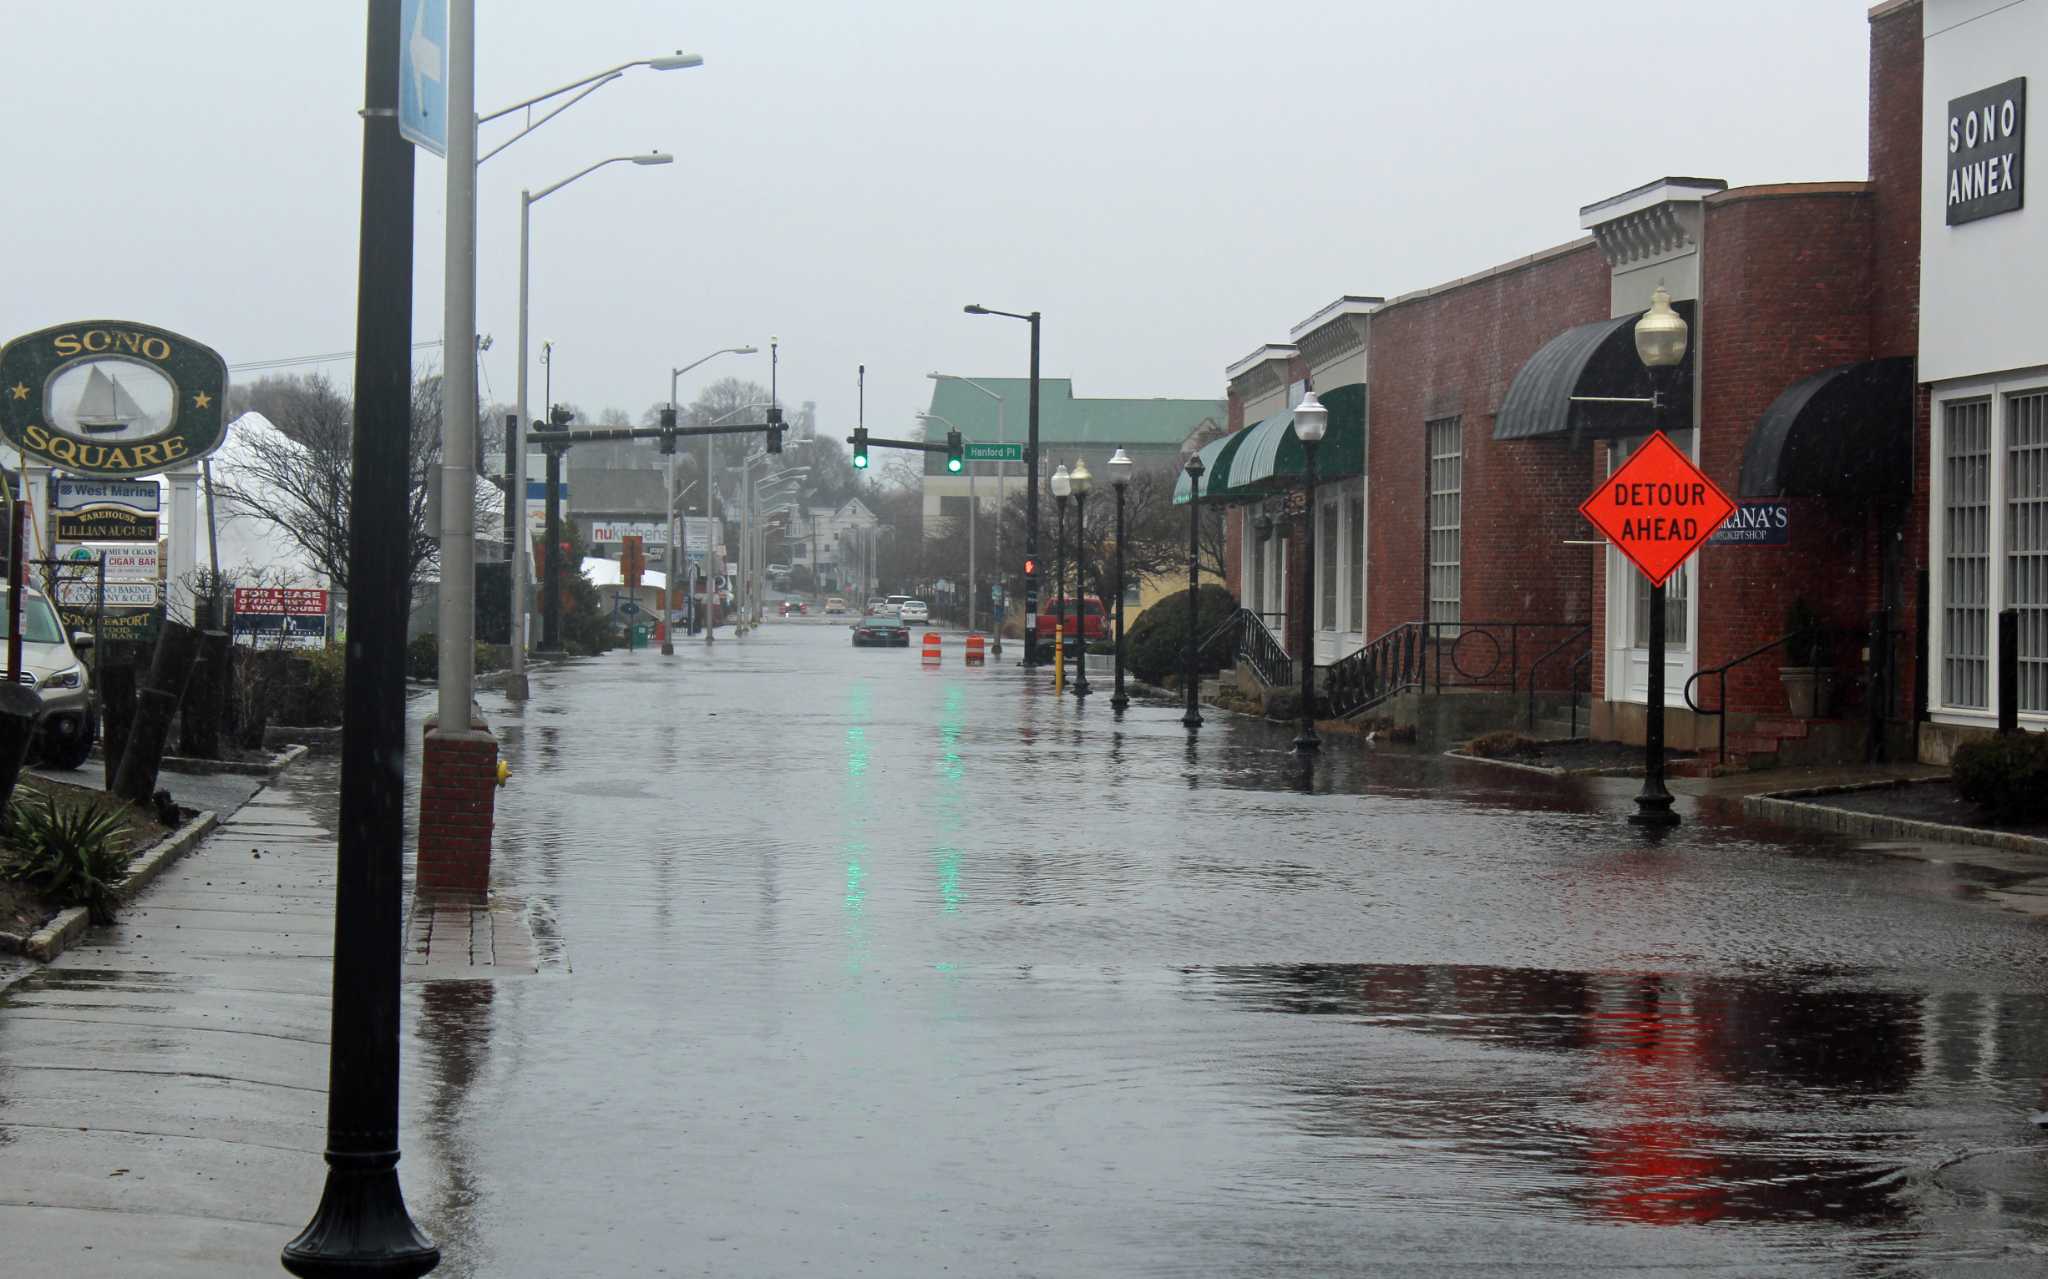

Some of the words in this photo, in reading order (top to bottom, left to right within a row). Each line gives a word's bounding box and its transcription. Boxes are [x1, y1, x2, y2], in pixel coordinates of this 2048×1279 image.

[1950, 99, 2015, 153] SONO
[1949, 153, 2013, 206] ANNEX
[54, 329, 172, 361] SONO
[23, 424, 189, 470] SQUARE
[74, 485, 107, 496] West
[111, 485, 156, 497] Marine
[1615, 483, 1706, 506] DETOUR
[80, 511, 137, 524] WAREHOUSE
[62, 525, 107, 536] LILLIAN
[108, 526, 156, 537] AUGUST
[1621, 518, 1698, 541] AHEAD
[1745, 530, 1767, 541] SHOP
[109, 557, 136, 566] CIGAR
[138, 557, 156, 566] BAR
[274, 591, 321, 599] LEASE
[252, 604, 321, 612] WAREOUSE
[103, 613, 150, 626] EAPORT
